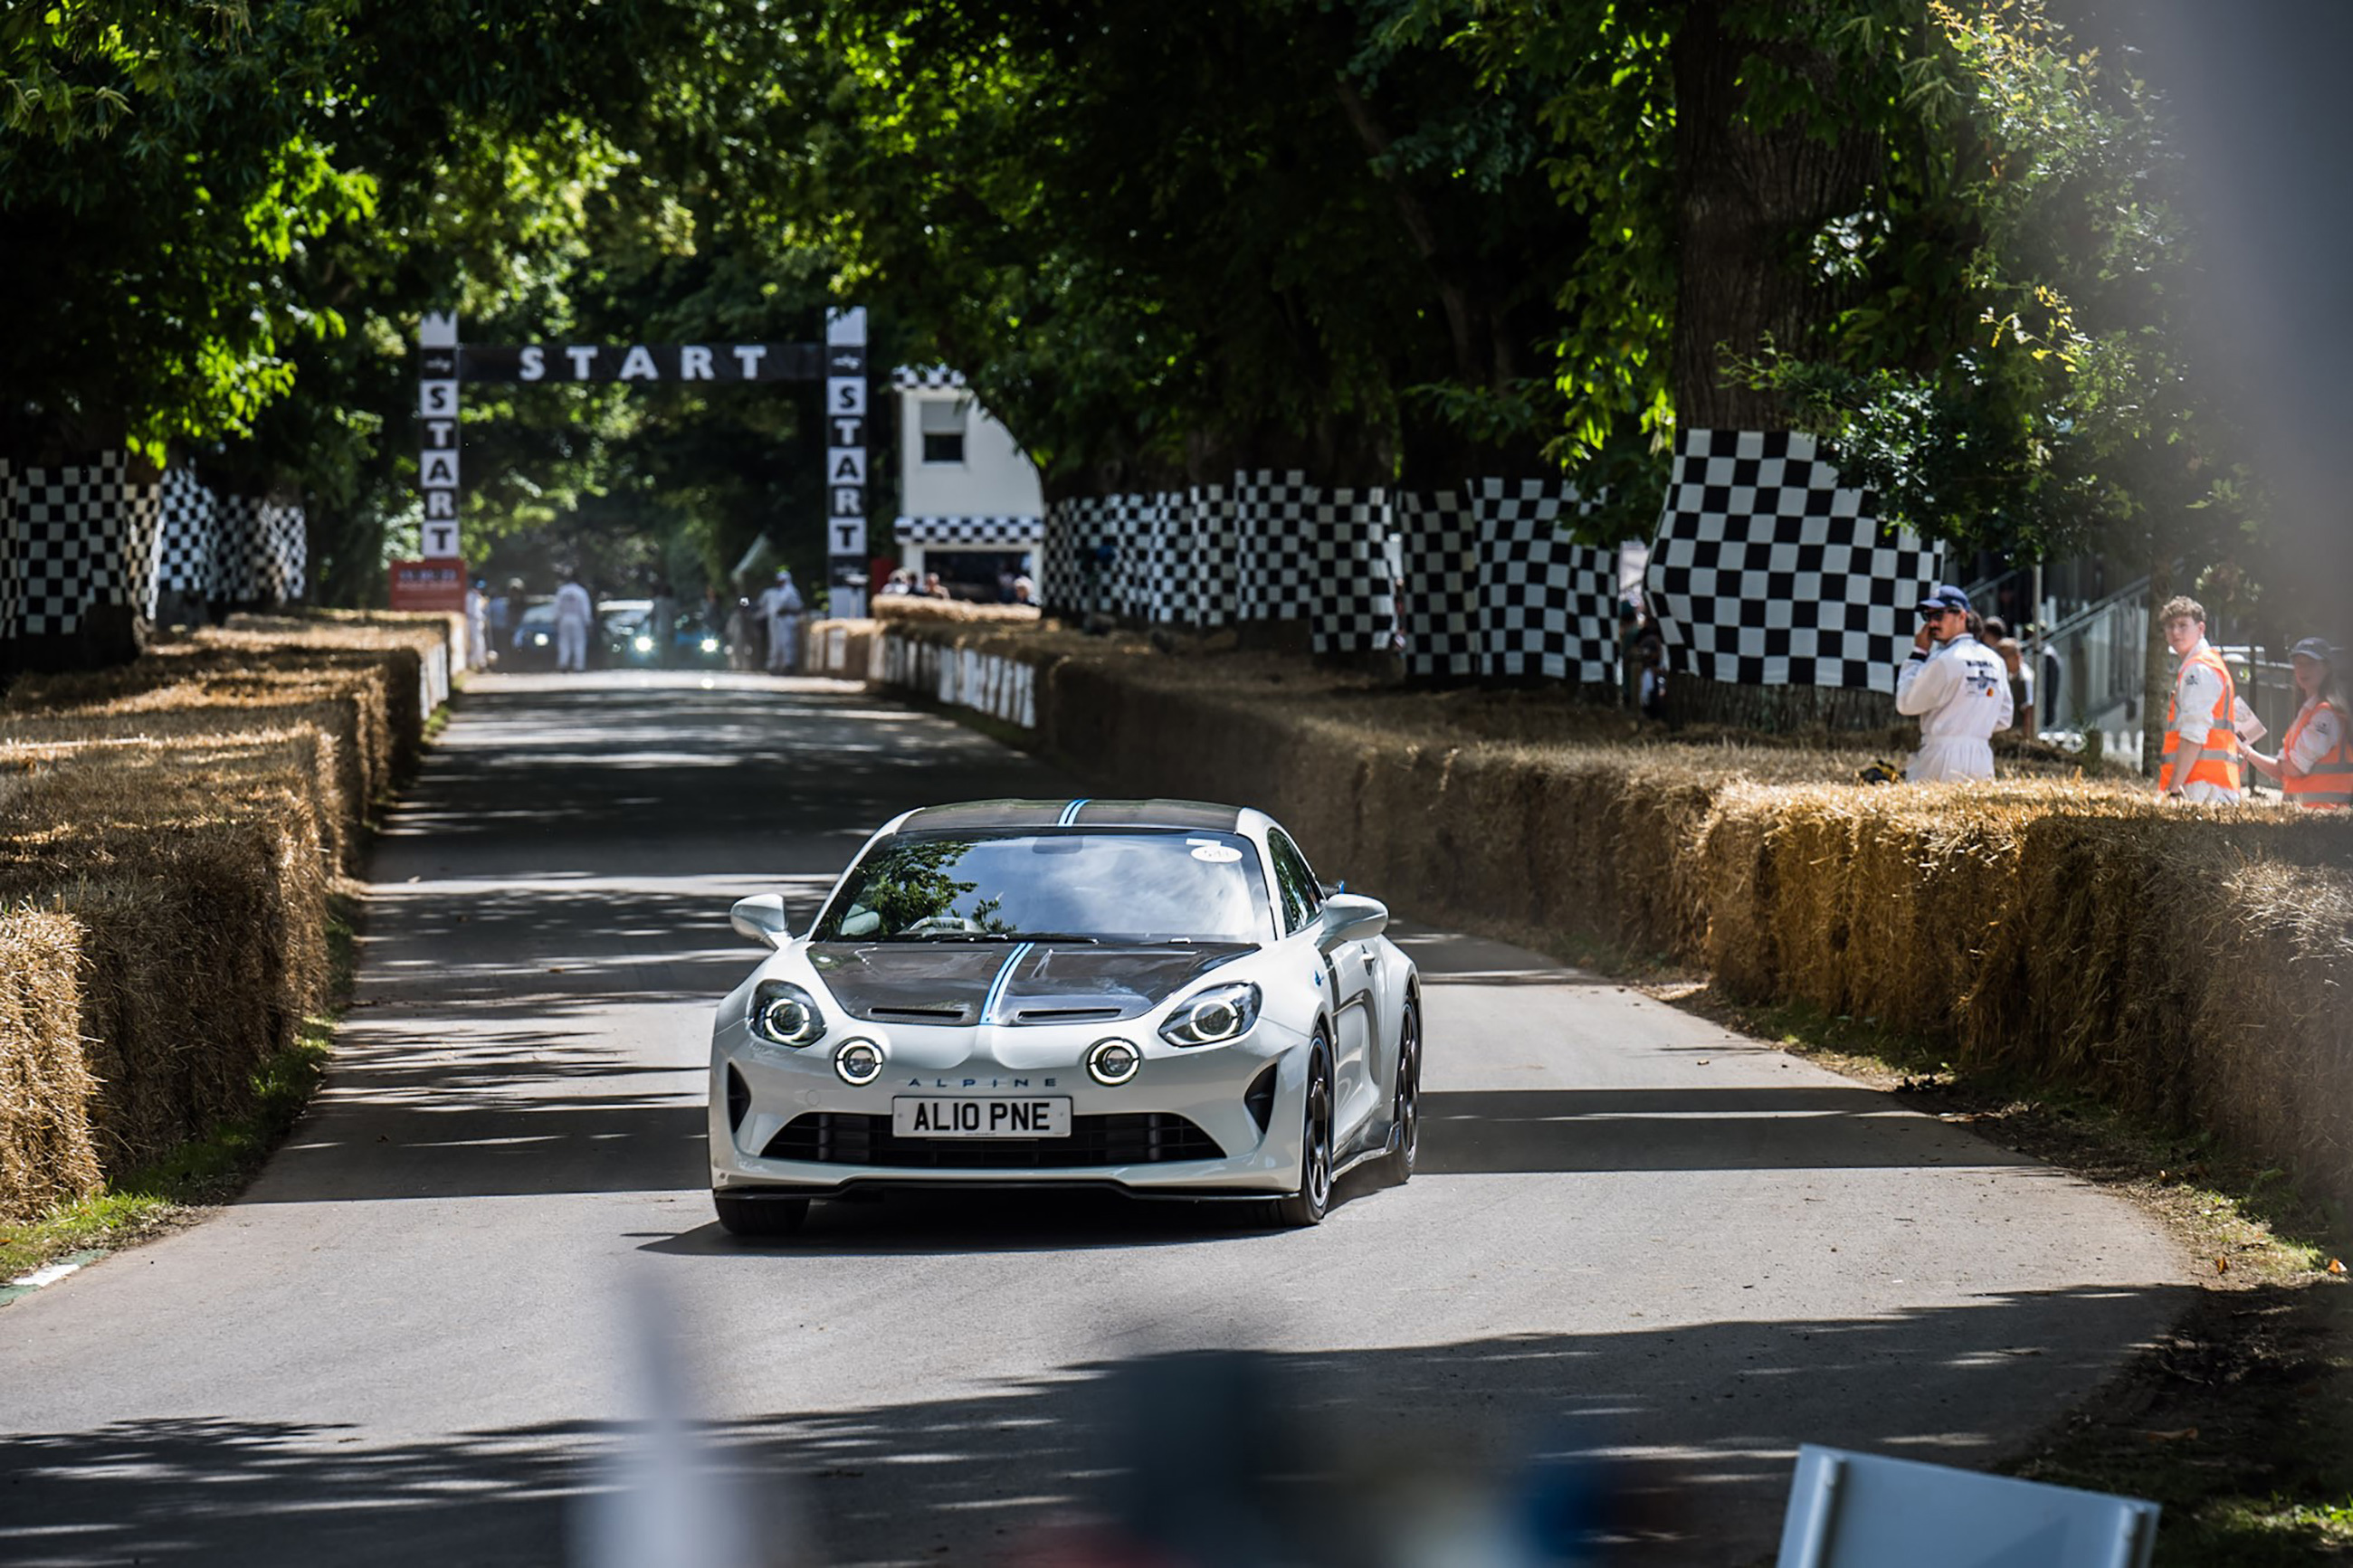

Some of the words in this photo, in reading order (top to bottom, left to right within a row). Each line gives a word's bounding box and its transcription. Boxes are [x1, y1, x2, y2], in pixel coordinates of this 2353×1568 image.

[519, 345, 767, 381] START
[426, 385, 453, 552] START
[834, 385, 862, 548] START
[908, 1078, 1057, 1088] ALPINE
[913, 1102, 979, 1131] AL10
[989, 1102, 1051, 1131] PNE
